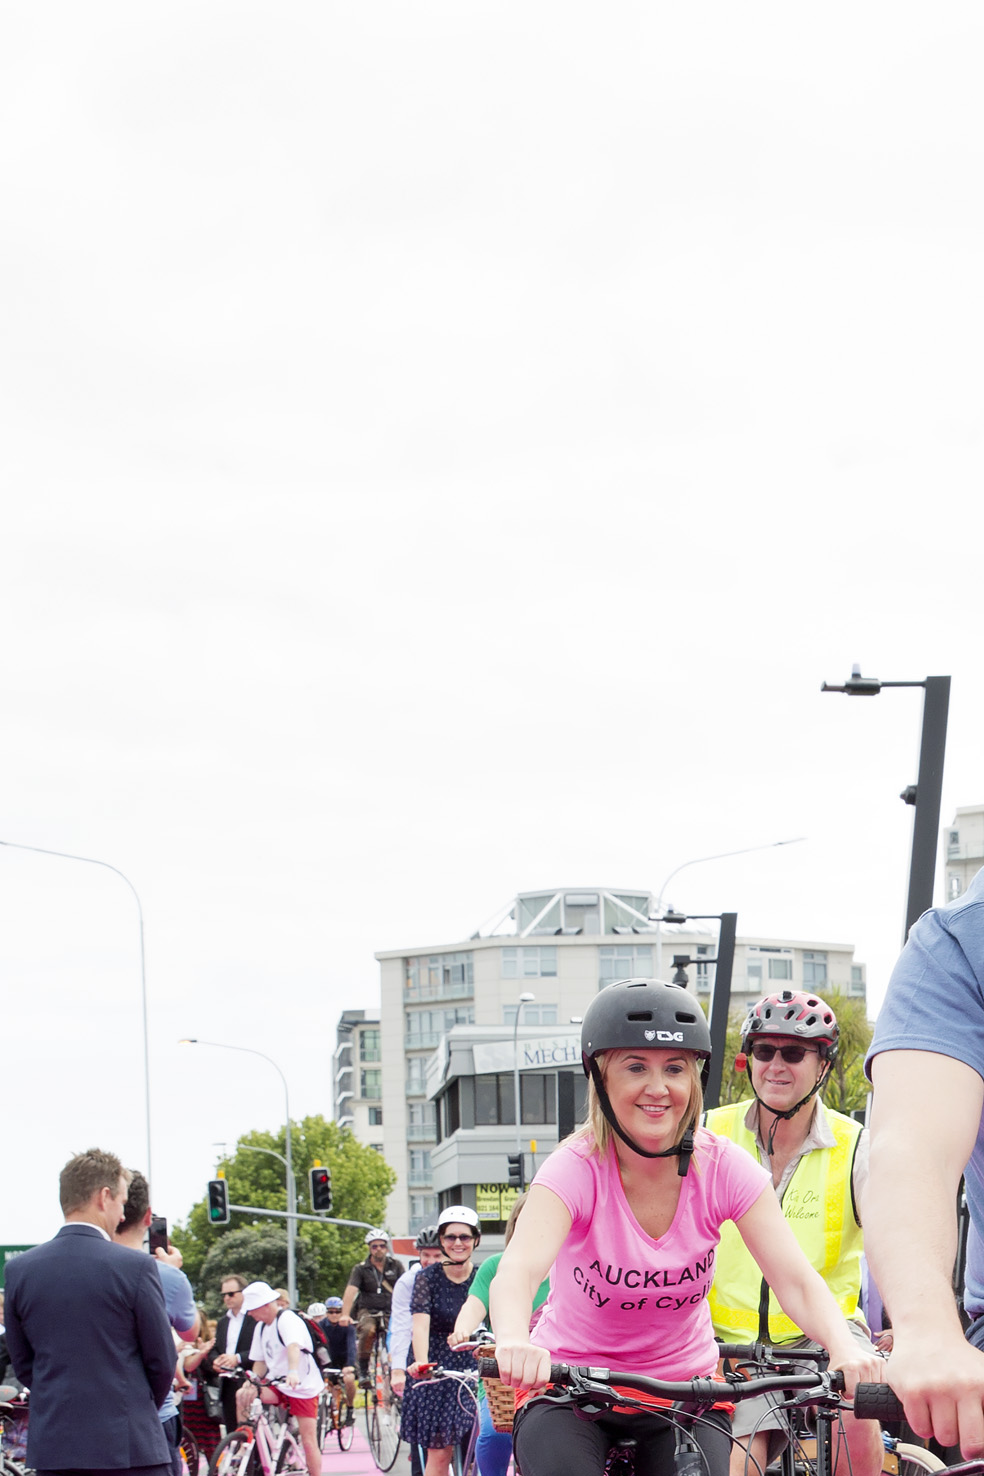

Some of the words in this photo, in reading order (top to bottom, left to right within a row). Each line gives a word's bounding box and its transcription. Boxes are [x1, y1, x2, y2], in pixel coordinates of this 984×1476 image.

[524, 1038, 580, 1051] BUSI
[524, 1046, 581, 1065] MECH
[589, 1248, 715, 1289] AUCKLAND
[573, 1266, 611, 1308] City
[620, 1297, 648, 1310] of
[655, 1280, 712, 1310] Cycli
